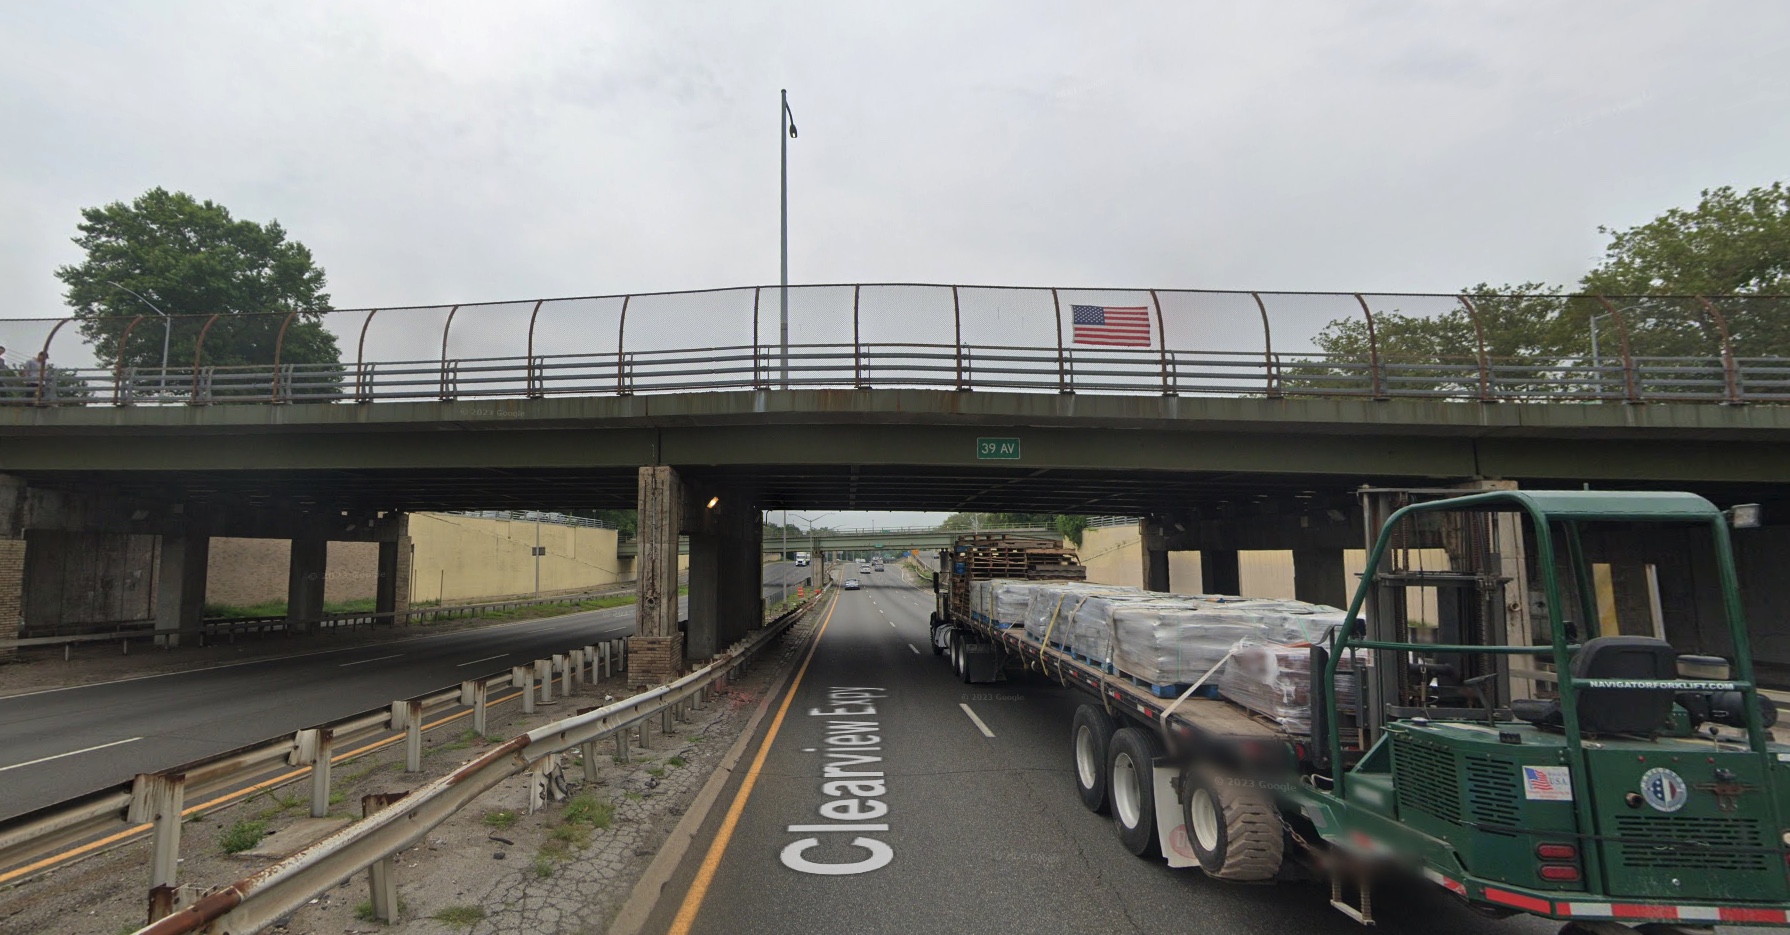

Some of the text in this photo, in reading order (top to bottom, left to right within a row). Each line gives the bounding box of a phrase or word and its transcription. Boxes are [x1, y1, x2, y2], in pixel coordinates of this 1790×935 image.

[981, 442, 1015, 454] 39 AV
[1589, 680, 1735, 691] NAVIGATORFORKLIFT.COM
